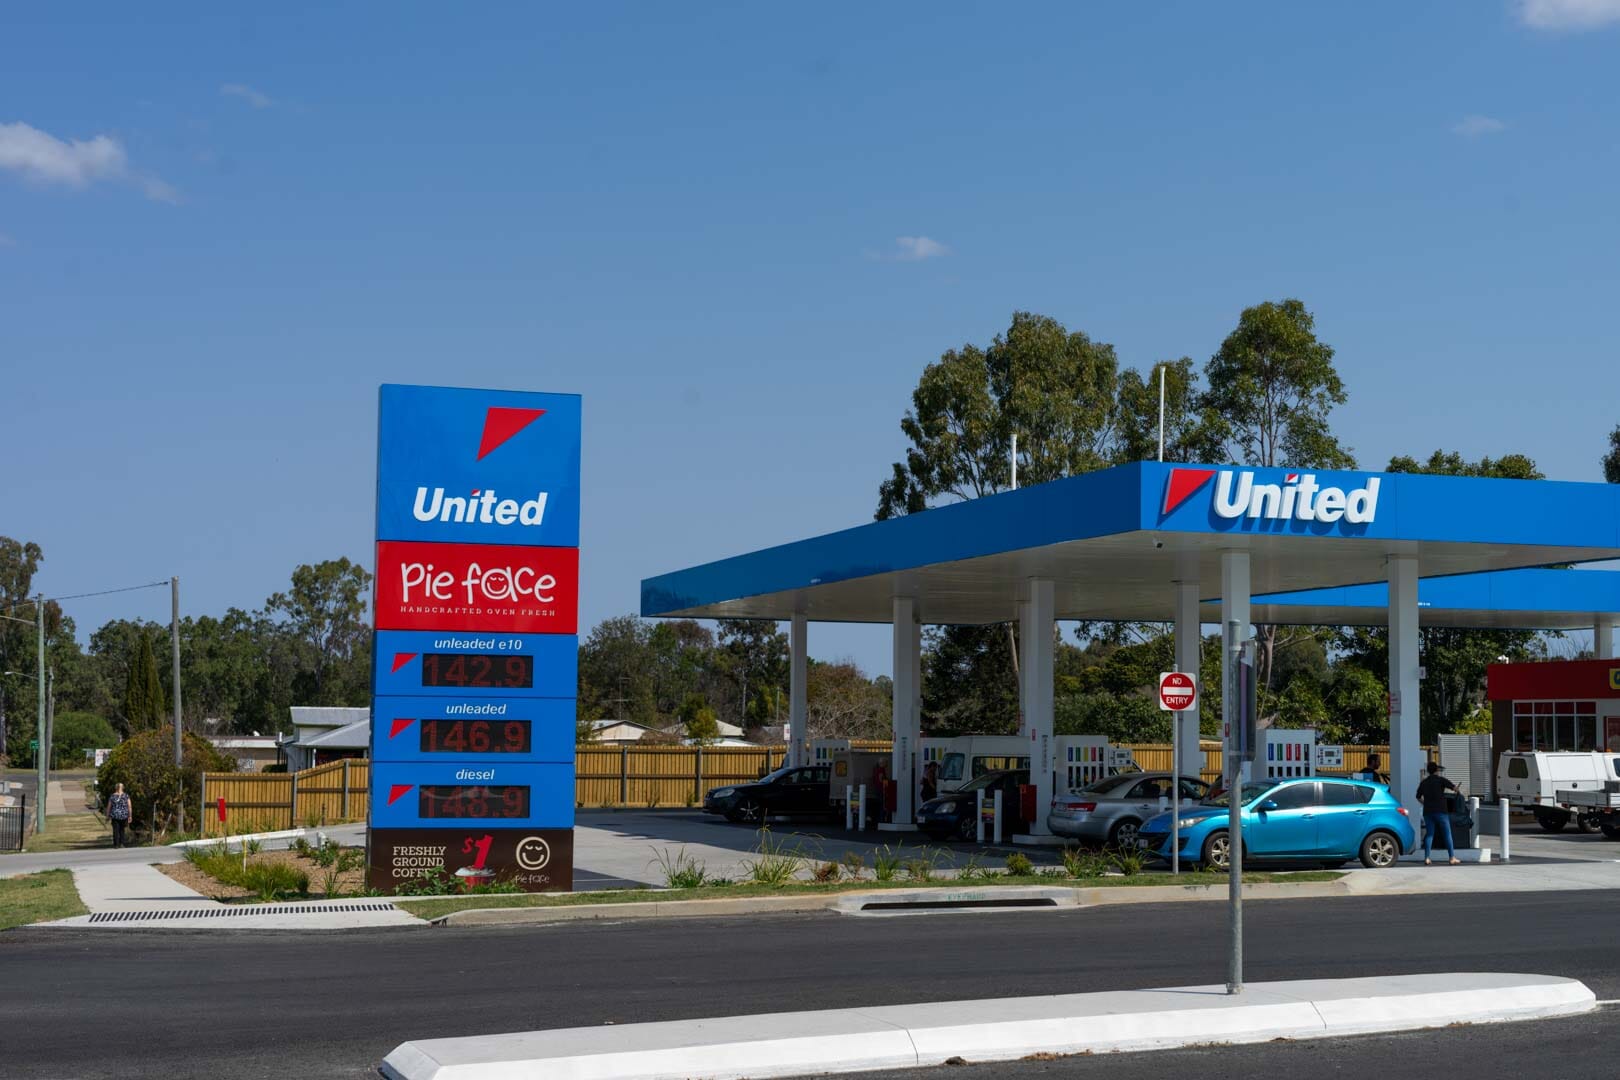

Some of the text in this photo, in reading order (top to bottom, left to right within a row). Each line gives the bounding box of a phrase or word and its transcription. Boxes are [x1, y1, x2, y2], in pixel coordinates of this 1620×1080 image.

[1213, 470, 1381, 523] United
[413, 487, 548, 525] United
[401, 563, 556, 604] Pie face
[400, 606, 555, 617] HANDCRAFTED OVEN FRESH
[434, 638, 522, 650] unleaded e10
[424, 655, 526, 687] 142.9
[1172, 677, 1182, 685] NO
[1166, 696, 1188, 705] ENTRY
[446, 703, 507, 715] unleaded
[422, 720, 525, 752] 146.9
[455, 769, 495, 780] diesel
[420, 787, 523, 818] 148.9
[392, 846, 446, 856] FRESHLY
[462, 834, 494, 869] $1
[392, 857, 444, 867] GROUND
[392, 867, 439, 878] COFF
